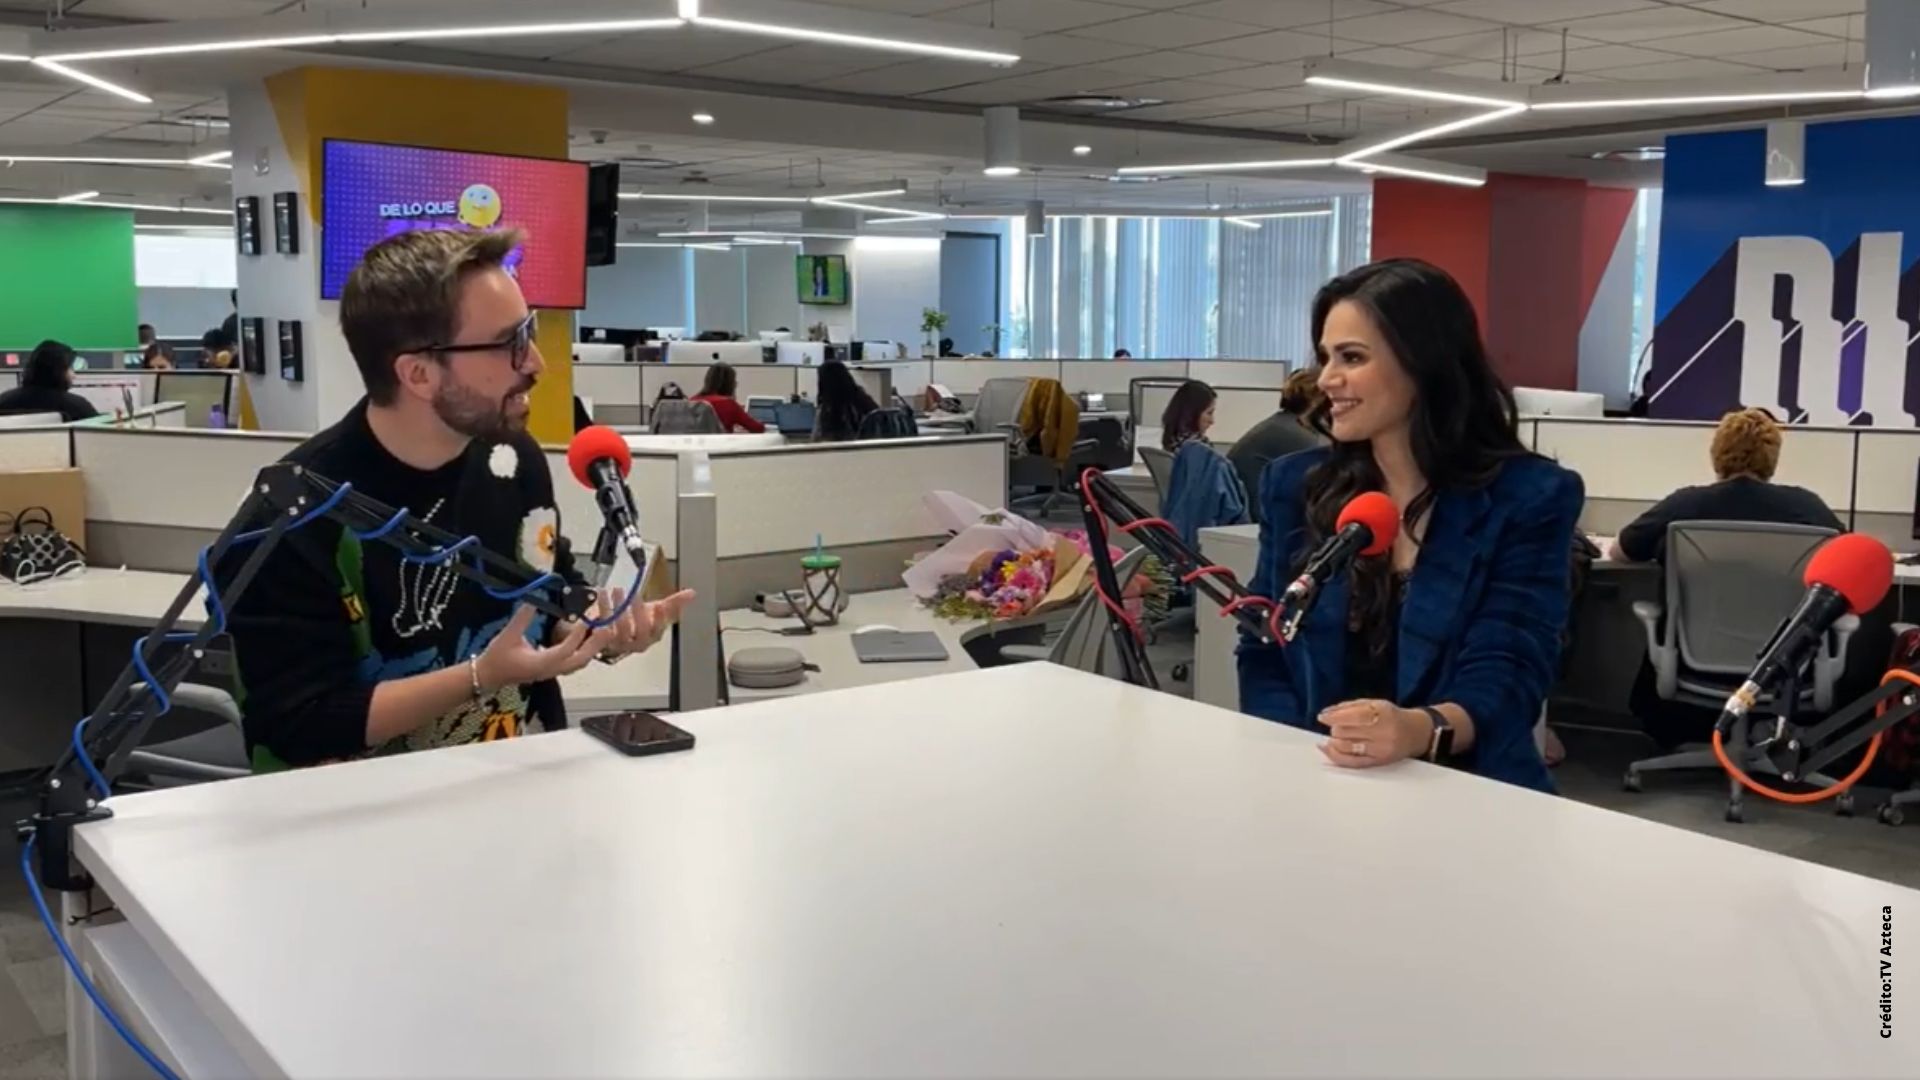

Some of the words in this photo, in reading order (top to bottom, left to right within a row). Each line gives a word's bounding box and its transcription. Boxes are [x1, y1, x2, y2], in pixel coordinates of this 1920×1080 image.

[379, 203, 401, 216] DE
[403, 202, 422, 215] LO
[424, 201, 456, 215] QUE
